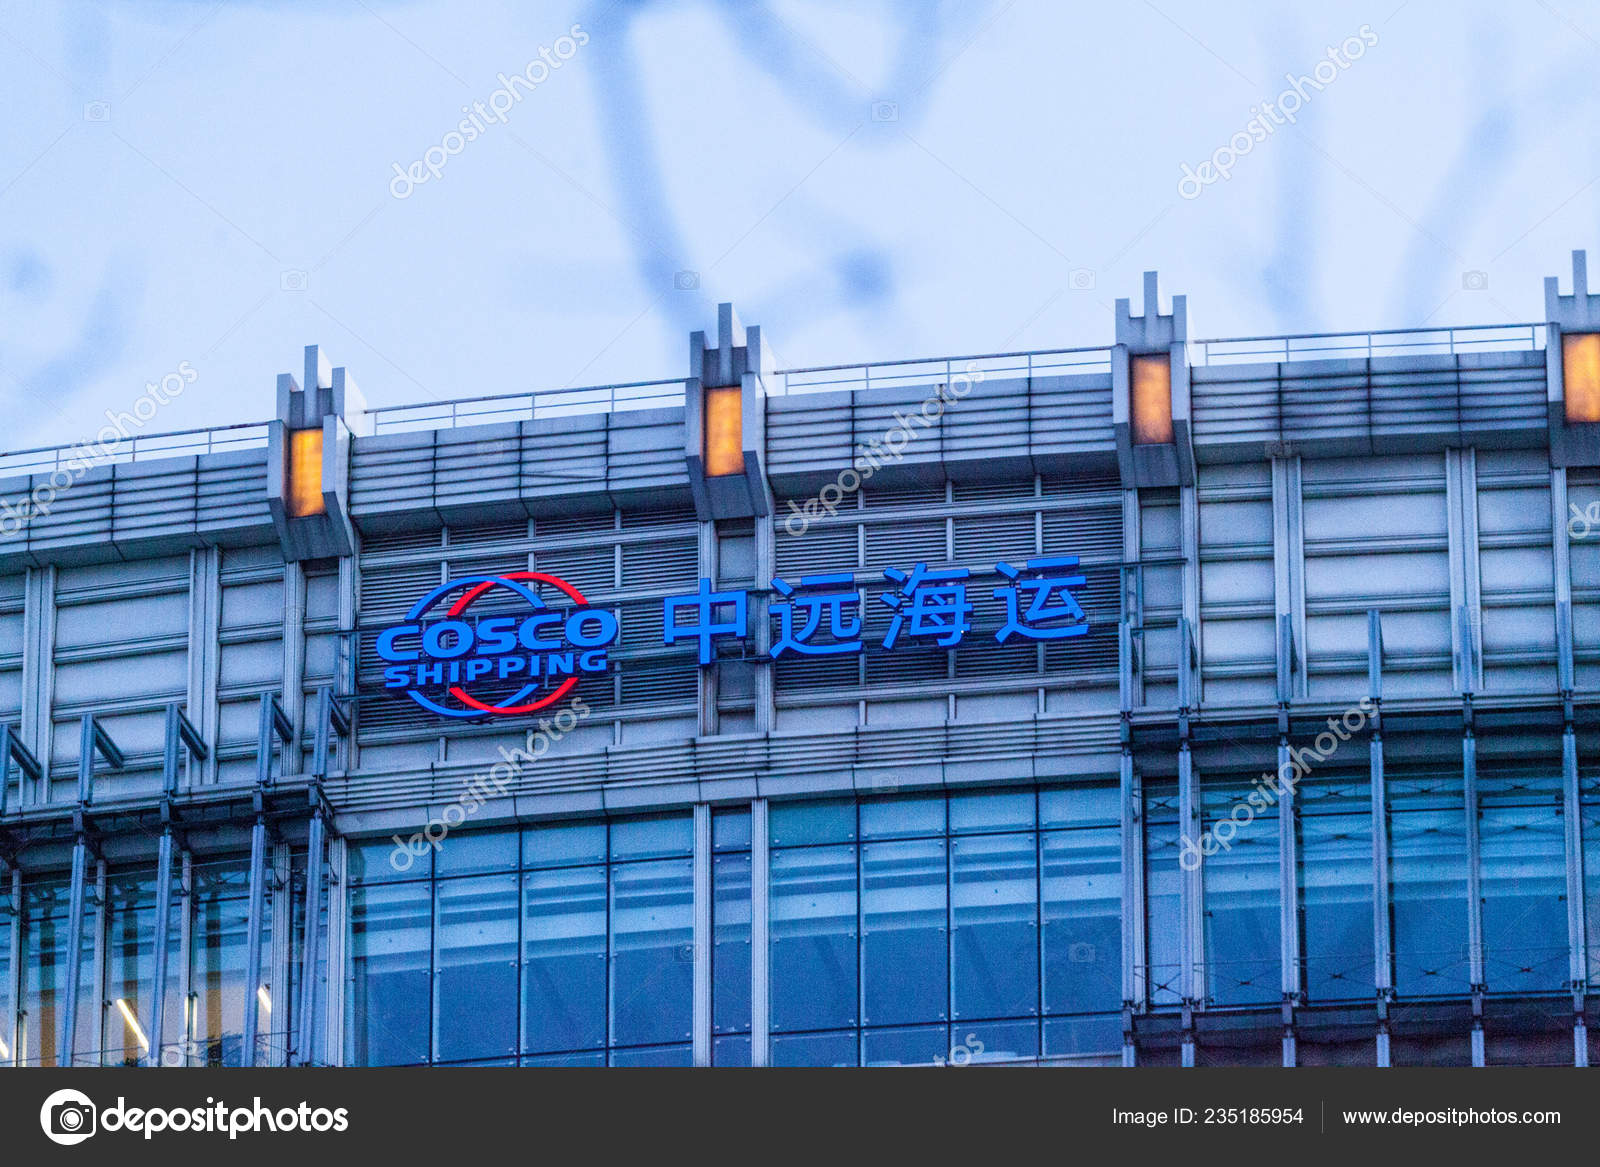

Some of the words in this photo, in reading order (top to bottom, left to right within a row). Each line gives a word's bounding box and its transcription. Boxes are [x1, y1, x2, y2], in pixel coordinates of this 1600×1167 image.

[375, 609, 618, 661] COSCO
[663, 555, 1090, 665] 中远海运
[383, 650, 607, 688] SHIPPING
